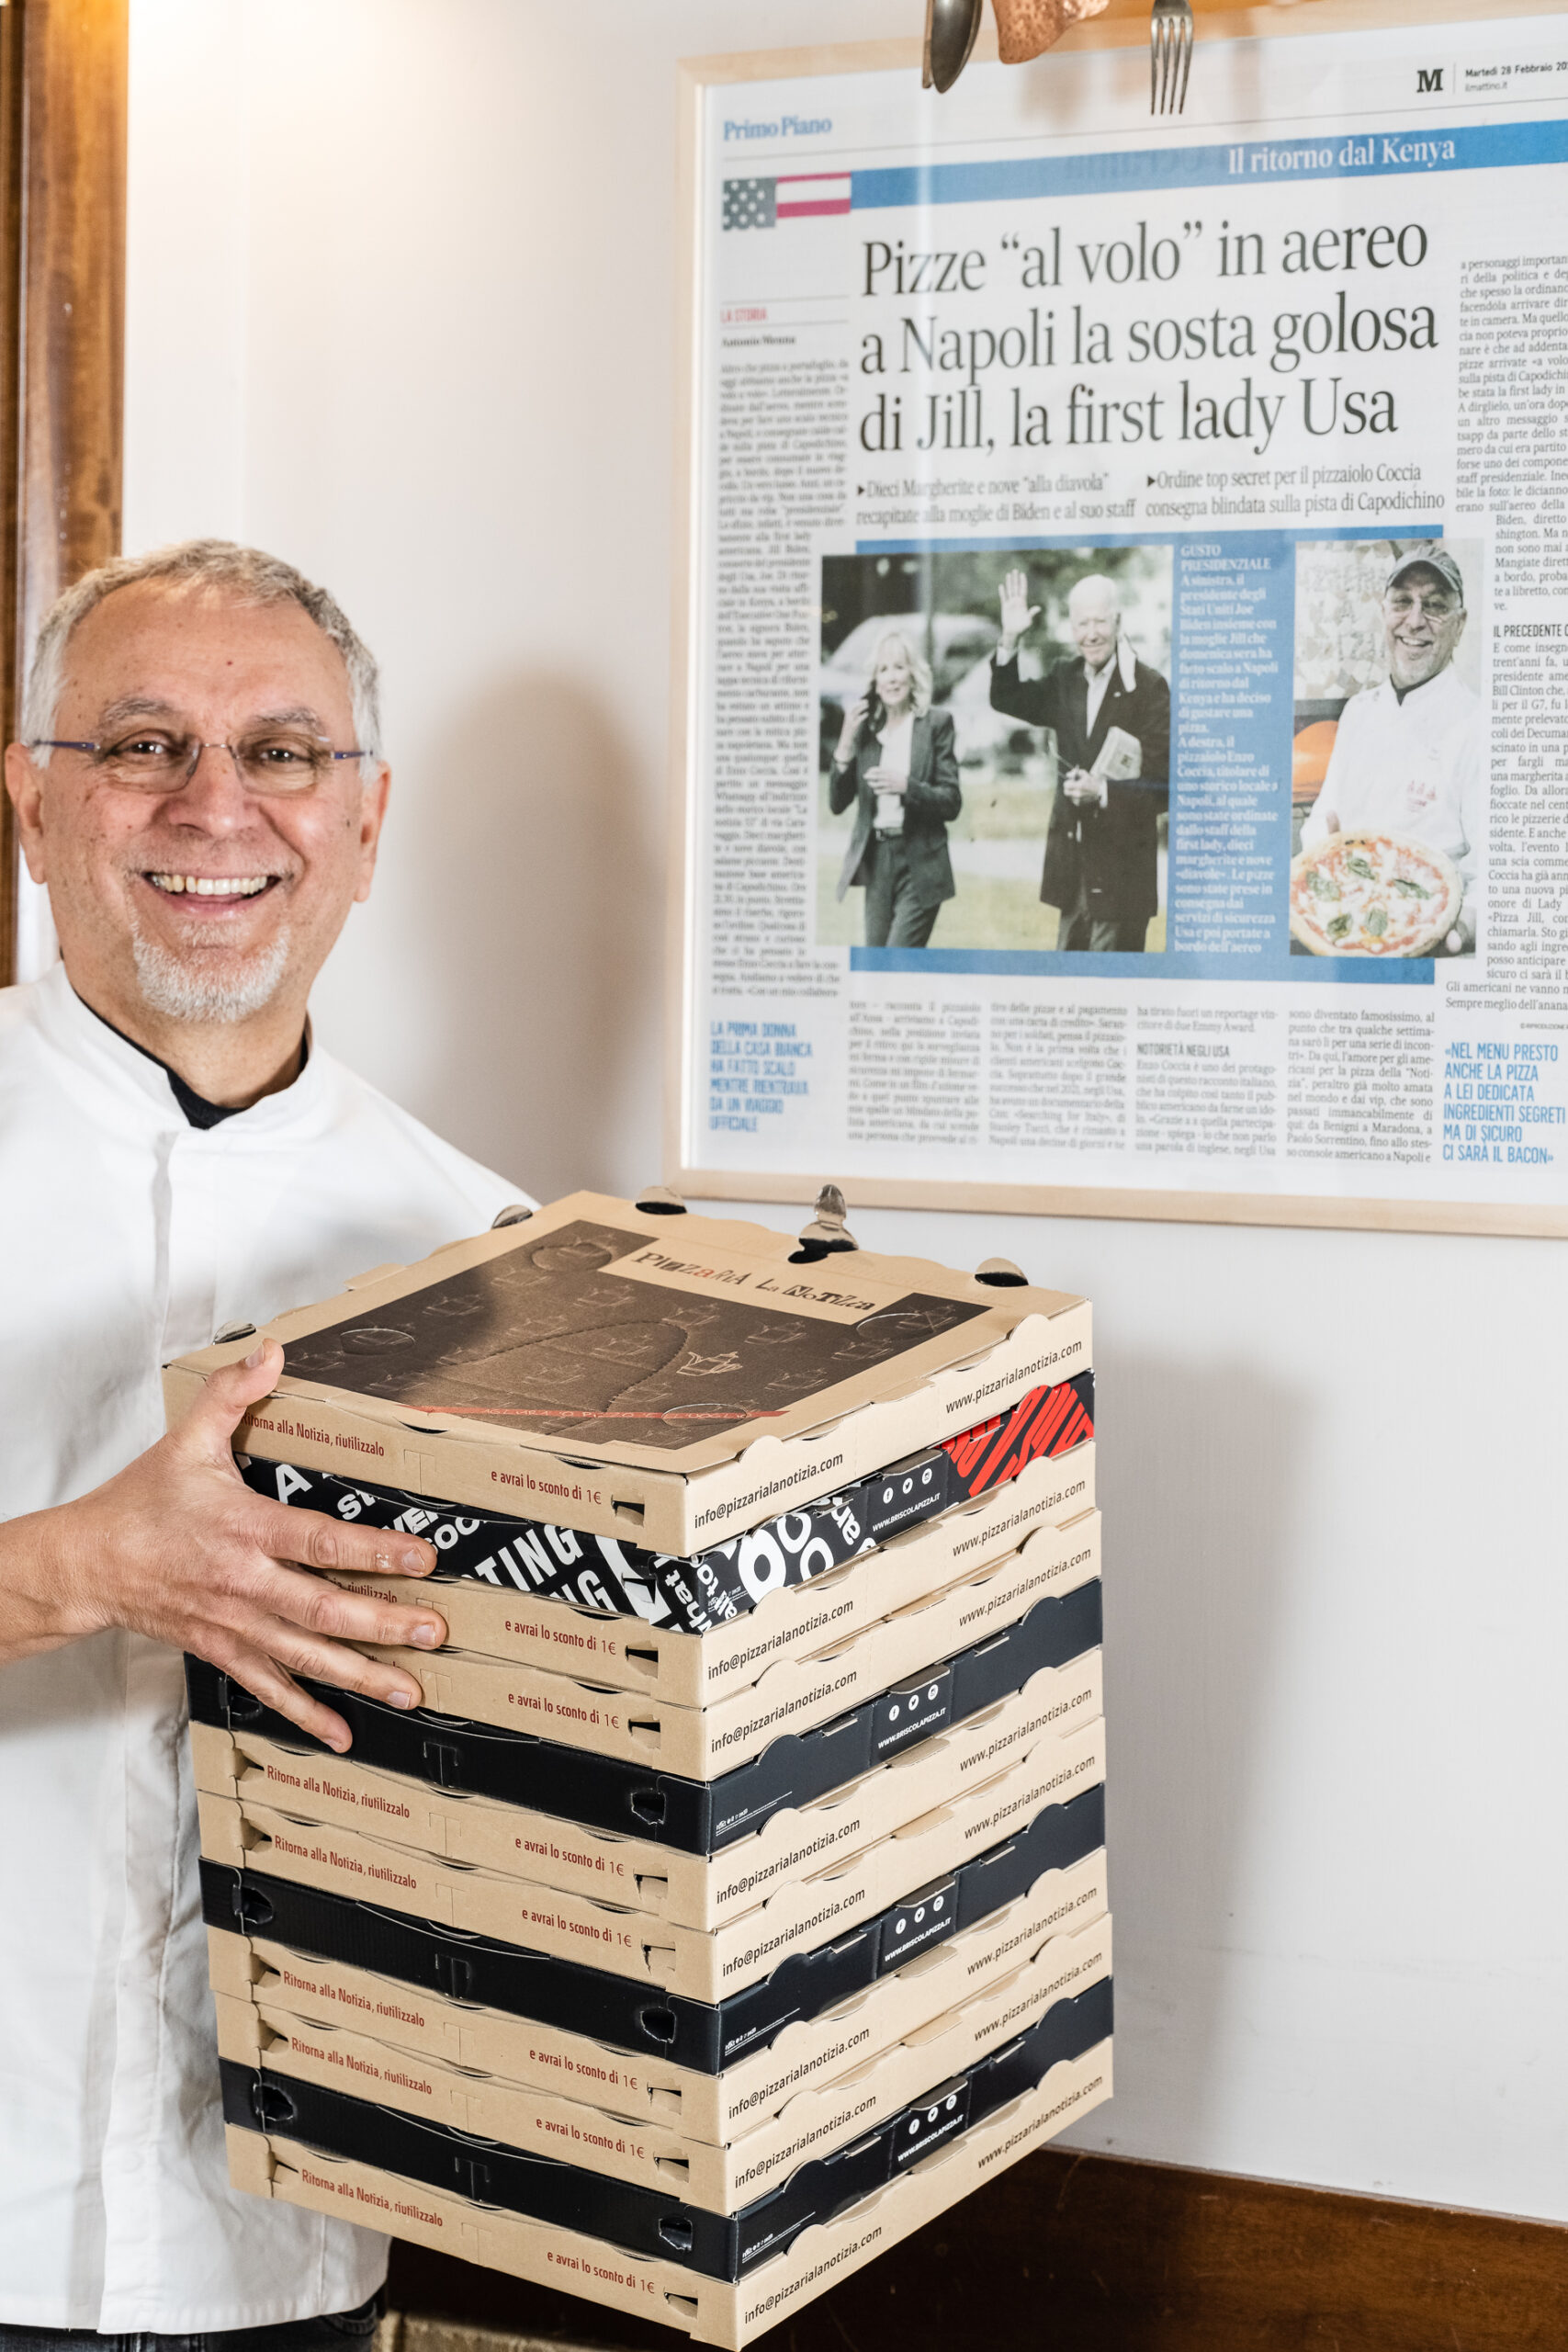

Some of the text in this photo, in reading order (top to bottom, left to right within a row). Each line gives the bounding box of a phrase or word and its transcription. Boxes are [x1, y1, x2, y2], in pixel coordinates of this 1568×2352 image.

[1417, 68, 1444, 93] M
[1501, 65, 1512, 76] 28
[1515, 62, 1553, 74] Febbraio
[723, 116, 832, 141] Primo Piano
[1228, 137, 1456, 175] Il ritorno dal Kenya
[862, 240, 986, 297] Pizze
[1217, 220, 1266, 277] in
[1282, 221, 1428, 274] aereo
[1469, 256, 1520, 272] personaggi
[1473, 269, 1539, 285] della politica
[1460, 298, 1550, 312] facendola arrivare
[861, 290, 1438, 387] a Napoli la sosta golosa
[860, 377, 1399, 456] di Jill, la first lady Usa
[868, 480, 900, 498] Dieci
[902, 477, 975, 502] Margherite
[977, 481, 985, 494] e
[988, 480, 1020, 493] nove
[1157, 463, 1421, 492] Ordine top secret per il pizzaiolo Coccia
[856, 499, 1137, 529] recapitate alla moglie di Biden e al suo staff
[1145, 490, 1445, 521] consegna blindata sulla pista di Capodichino
[1496, 514, 1567, 526] Biden, diretto
[1494, 624, 1562, 638] IL PRECEDENTE
[1493, 684, 1544, 696] Bill Clinton
[1446, 981, 1512, 993] Gli americani
[1446, 997, 1517, 1012] Sempre meglio
[1445, 1062, 1540, 1081] ANCHE LA PIZZA
[1477, 1043, 1510, 1060] MENU
[1514, 1044, 1559, 1062] PRESTO
[1444, 1082, 1535, 1102] A LEI DEDICATA
[1443, 1103, 1566, 1125] INGREDIENTI SEGRETI
[1443, 1124, 1523, 1143] MA DI SICURO
[1443, 1144, 1454, 1161] CI
[1458, 1142, 1489, 1162] SARÀ
[1494, 1146, 1504, 1163] IL
[945, 1340, 1082, 1414] www.pizzarialanotizia.com
[276, 1419, 294, 1435] alla
[296, 1423, 333, 1446] Notizia,
[335, 1434, 385, 1456] riutilizzalo
[491, 1470, 602, 1505] e avrai lo sconto di 1€
[694, 1453, 843, 1529] info@pizzarialanotizia.com
[873, 1492, 941, 1532] WWW.BRISCOLAPIZZA.IT
[953, 1479, 1086, 1556] www.pizzarialanotizia.com
[959, 1548, 1091, 1627] www.pizzarialanotizia.com
[708, 1600, 853, 1680] info@pizzarialanotizia.com
[711, 1669, 857, 1753] info@pizzarialanotizia.com
[877, 1707, 946, 1749] WWW.BRISCOLAPIZZA.IT
[960, 1689, 1091, 1771] www.pizzarialanotizia.com
[267, 1765, 411, 1819] Ritorna alla Notizia, riutilizzalo
[964, 1755, 1095, 1839] www.pizzarialanotizia.com
[515, 1838, 625, 1877] e avrai lo sconto di 1€
[716, 1818, 860, 1905] info@pizzarialanotizia.com
[723, 1887, 865, 1977] info@pizzarialanotizia.com
[967, 1886, 1098, 1975] www.pizzarialanotizia.com
[974, 1951, 1102, 2041] www.pizzarialanotizia.com
[728, 2027, 870, 2120] info@pizzarialanotizia.com
[735, 2094, 876, 2188] info@pizzarialanotizia.com
[977, 2075, 1102, 2169] www.pizzarialanotizia.com
[301, 2169, 443, 2227] Ritorna alla Notizia, riutilizzalo
[547, 2251, 655, 2294] e avrai lo sconto di 1€
[745, 2226, 882, 2324] info@pizzarialanotizia.com
